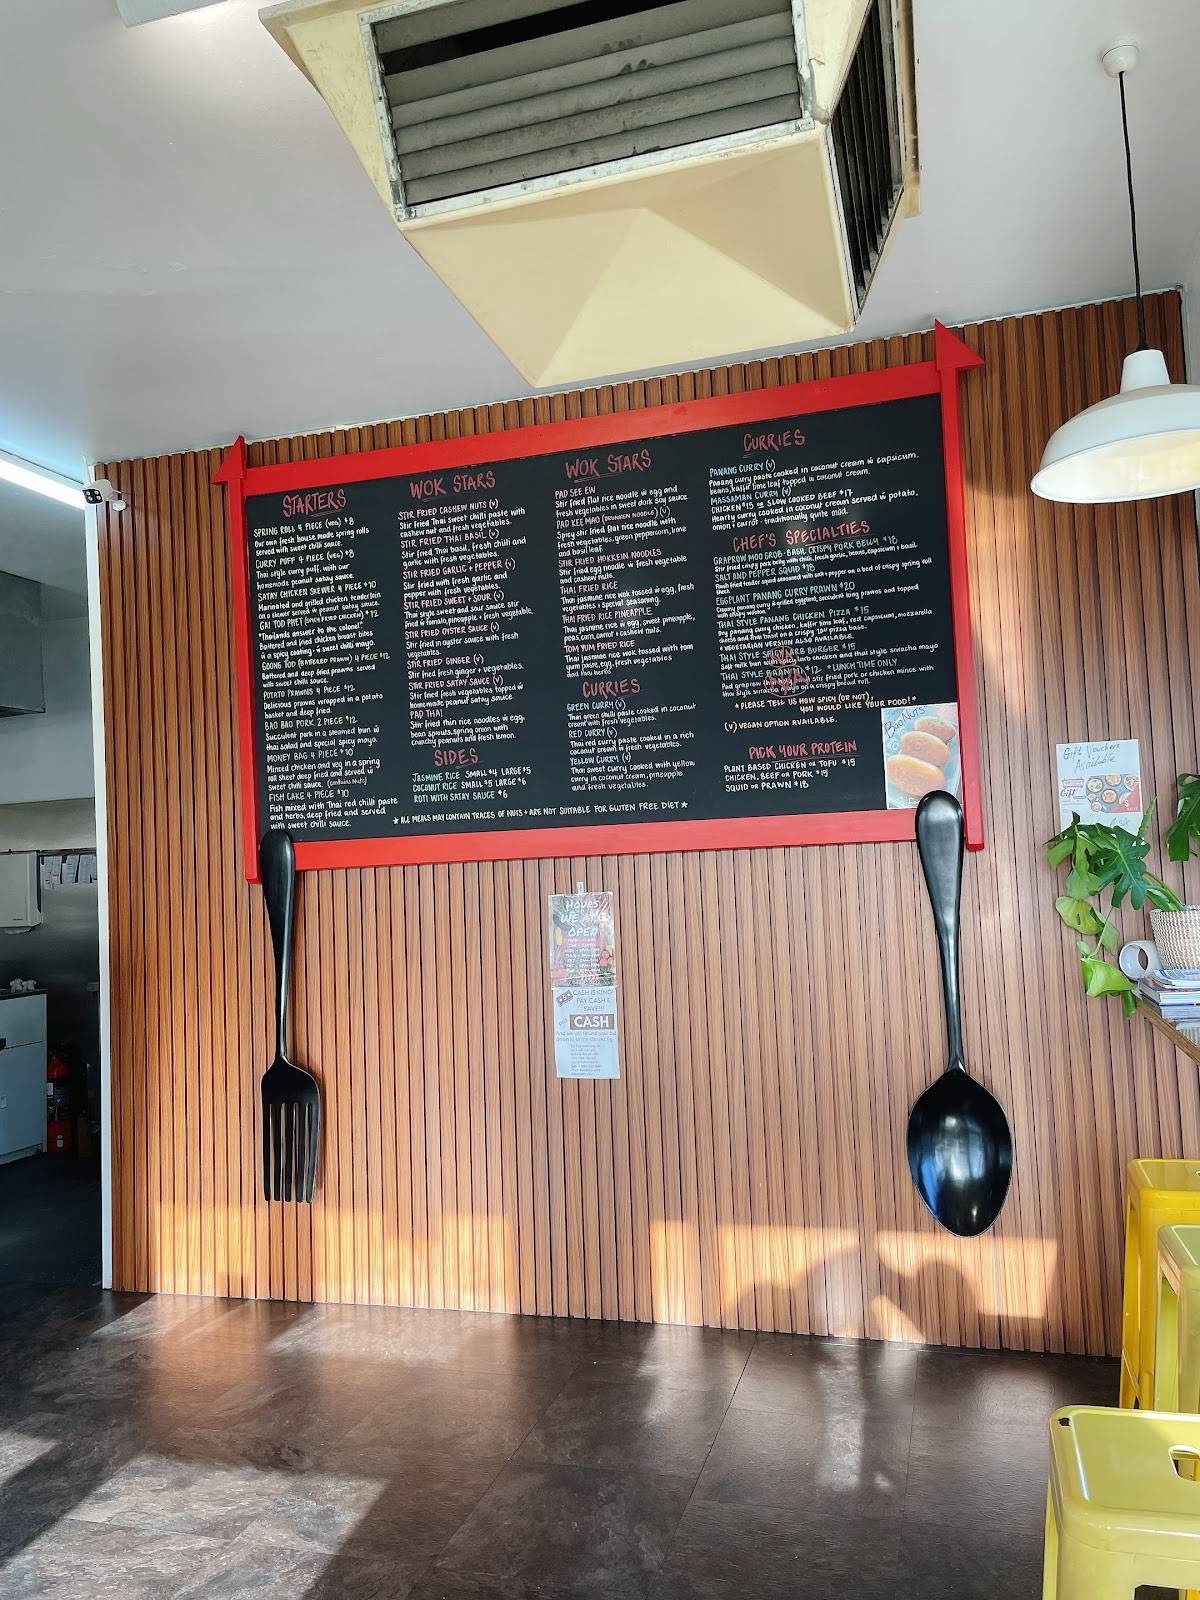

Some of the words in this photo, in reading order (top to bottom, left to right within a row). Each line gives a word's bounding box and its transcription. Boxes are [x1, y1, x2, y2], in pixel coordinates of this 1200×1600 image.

[743, 429, 805, 451] CURRIES
[565, 458, 600, 479] WOK
[607, 449, 651, 473] STARS
[709, 465, 737, 478] PANANG
[738, 462, 764, 473] CURRY
[409, 478, 447, 499] WOK
[453, 470, 496, 492] STARS
[555, 490, 568, 499] PAD
[570, 488, 582, 497] SEE
[584, 485, 596, 495] EW
[282, 489, 347, 517] STARTERS
[398, 511, 416, 520] STIR
[416, 508, 437, 518] FRIED
[439, 504, 467, 514] CASHEW
[469, 501, 487, 510] NUTS
[794, 501, 823, 511] coconut
[824, 500, 850, 508] cream
[851, 494, 878, 504] served
[399, 521, 412, 530] Stir
[413, 519, 430, 529] fried
[431, 518, 446, 526] Thai
[447, 514, 468, 523] sweet
[469, 511, 486, 520] chilli
[488, 509, 508, 520] paste
[510, 506, 526, 516] with
[253, 528, 278, 538] SPRING
[280, 525, 296, 534] ROLL
[298, 524, 303, 532] 4
[305, 521, 322, 531] PIECE
[732, 532, 776, 552] CHEF'S
[785, 520, 870, 545] SPECIALTIES
[400, 539, 417, 549] STIR
[419, 537, 442, 547] FRIED
[444, 534, 461, 543] THAI
[464, 532, 487, 541] BASIL
[255, 559, 277, 570] CURRY
[280, 556, 296, 566] PUFF
[306, 553, 324, 562] PIECE
[558, 559, 574, 568] STIR
[574, 557, 594, 566] FRIED
[631, 548, 662, 559] NOODLES
[715, 573, 731, 582] SALT
[732, 571, 747, 580] AND
[748, 567, 776, 579] PEPPER
[778, 565, 801, 576] SQUID
[560, 585, 576, 595] THAI
[578, 584, 599, 594] FRIED
[601, 581, 618, 590] RICE
[715, 593, 750, 606] EGGPLANT
[752, 590, 782, 602] PANANG
[784, 587, 808, 598] CURRY
[810, 583, 838, 595] PRAWN
[404, 631, 419, 640] STIR
[420, 629, 440, 639] FRIED
[441, 626, 466, 636] OYSTER
[467, 624, 488, 633] SAUCE
[564, 644, 579, 653] TOM
[580, 643, 595, 652] YUM
[597, 641, 617, 651] FRIED
[619, 640, 635, 648] RICE
[582, 678, 640, 699] CURRIES
[410, 710, 424, 720] PAD
[425, 709, 443, 718] THAI
[566, 702, 589, 712] GREEN
[592, 701, 614, 710] CURRY
[264, 721, 278, 731] BAO
[296, 718, 314, 729] PORK
[317, 718, 322, 727] 2
[324, 716, 343, 726] PIECE
[738, 722, 762, 730] VEGAN
[764, 720, 790, 729] OPTION
[267, 753, 290, 763] MONEY
[294, 752, 307, 761] BAG
[318, 749, 338, 758] PIECE
[434, 747, 479, 767] SIDES
[748, 745, 776, 760] PICK
[778, 743, 808, 758] YOUR
[810, 740, 857, 755] PROTEIN
[570, 756, 595, 766] YELLOW
[596, 755, 619, 764] CURRY
[724, 764, 745, 773] PLANT
[747, 763, 771, 771] BASED
[774, 761, 807, 770] CHICKEN
[819, 759, 837, 767] TOFU
[412, 772, 444, 782] JASMINE
[445, 771, 460, 780] RICE
[465, 769, 487, 778] SMALL
[501, 766, 521, 776] LARGE
[412, 782, 440, 792] COCONUT
[442, 781, 457, 791] RICE
[461, 780, 483, 789] SMALL
[495, 778, 516, 787] LARGE
[725, 783, 749, 793] SQUID
[761, 780, 792, 790] PRAWN
[269, 792, 285, 802] FISH
[287, 791, 304, 801] CAKE
[314, 789, 334, 799] PIECE
[414, 793, 428, 804] ROTI
[430, 792, 448, 802] WITH
[450, 791, 469, 801] SATAY
[472, 790, 495, 800] SAUCE
[269, 804, 283, 813] Fish
[285, 802, 306, 811] mixed
[309, 801, 325, 810] with
[326, 800, 342, 809] Thai
[344, 799, 356, 807] red
[358, 797, 375, 806] chilli
[378, 797, 398, 808] paste
[400, 816, 411, 824] ALL
[412, 814, 431, 824] MEALS
[432, 813, 445, 822] MAY
[445, 812, 471, 821] CONTAIN
[471, 811, 496, 820] TRACES
[497, 810, 505, 818] OF
[507, 809, 523, 817] NUTS
[529, 808, 542, 816] ARE
[543, 807, 556, 815] NOT
[559, 805, 591, 815] SUITABLE
[594, 804, 607, 813] FOR
[608, 803, 636, 812] GLUTEN
[639, 802, 659, 811] FREE
[661, 801, 679, 809] DIET
[568, 927, 599, 938] OPEN
[573, 1015, 610, 1028] CASH
